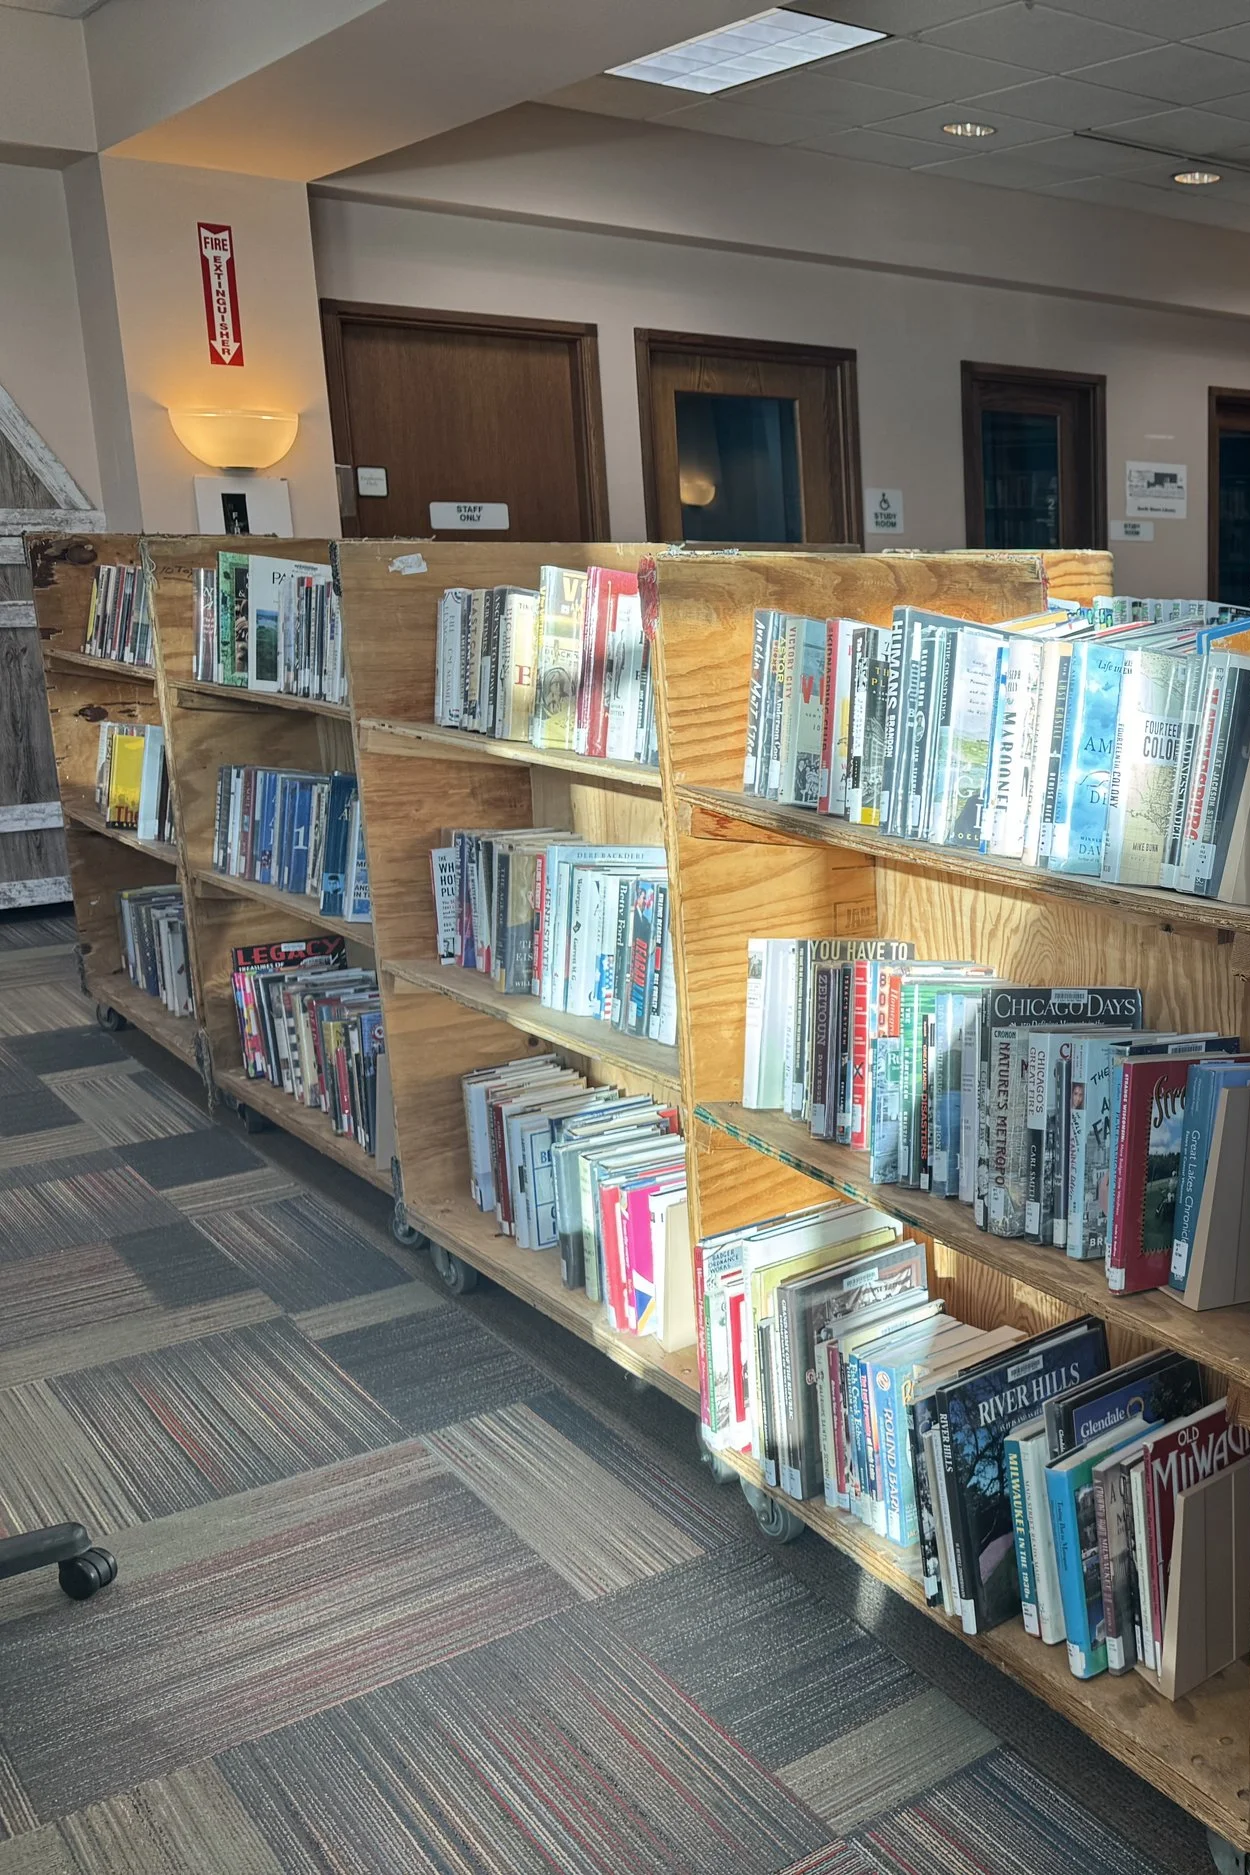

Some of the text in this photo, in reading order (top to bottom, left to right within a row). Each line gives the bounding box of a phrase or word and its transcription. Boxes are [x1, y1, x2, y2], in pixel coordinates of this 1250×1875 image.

[204, 236, 229, 252] FIRE
[213, 255, 231, 356] EXTINGUISHER
[457, 505, 483, 513] STAFF
[459, 514, 481, 522] ONLY
[874, 512, 897, 520] STUDY
[875, 520, 897, 528] ROOM
[469, 598, 479, 677] LAST CALL
[491, 594, 500, 661] ASCENT TO
[502, 637, 511, 674] BURN
[785, 626, 797, 700] VICTORY CITY
[773, 635, 787, 741] ASTOR Anderson
[885, 620, 904, 758] HUMANS BRANDON
[940, 639, 952, 721] THE GRAND IDEA
[1145, 720, 1180, 738] FOURTEE
[1108, 723, 1125, 809] FOURTEENTH COLONY
[1215, 758, 1222, 770] AT
[1208, 771, 1220, 807] JACKSON
[544, 887, 552, 918] KENT
[575, 879, 583, 917] Watergate
[617, 884, 628, 947] Betty Ford
[811, 941, 908, 961] YOU HAVE TO
[816, 973, 829, 1047] ZEITOUN
[994, 994, 1136, 1018] CHICAGO DAYS
[994, 1030, 1016, 1039] CRONON
[1028, 1047, 1037, 1117] GREAT FIRE
[1036, 1050, 1046, 1114] CHICAGO'S
[1091, 1067, 1110, 1086] THE
[1122, 1073, 1130, 1103] STRANGE
[995, 1042, 1011, 1188] NATURE'S METROPO
[1030, 1144, 1038, 1169] CARL
[1188, 1130, 1200, 1161] Great
[1186, 1163, 1197, 1192] Lakes
[850, 1363, 858, 1384] Fish
[851, 1386, 860, 1416] Creek
[978, 1385, 1030, 1426] RIVER
[1032, 1362, 1080, 1402] HILLS
[854, 1420, 862, 1451] Echoes
[884, 1408, 896, 1467] ROUND
[1080, 1407, 1125, 1438] Glendale
[1178, 1427, 1200, 1446] OLD
[940, 1413, 954, 1473] RIVER HILLS
[868, 1463, 876, 1480] Lake
[1008, 1453, 1028, 1569] MILWAUKEE IN THE
[1101, 1538, 1112, 1591] MILWAUKEE
